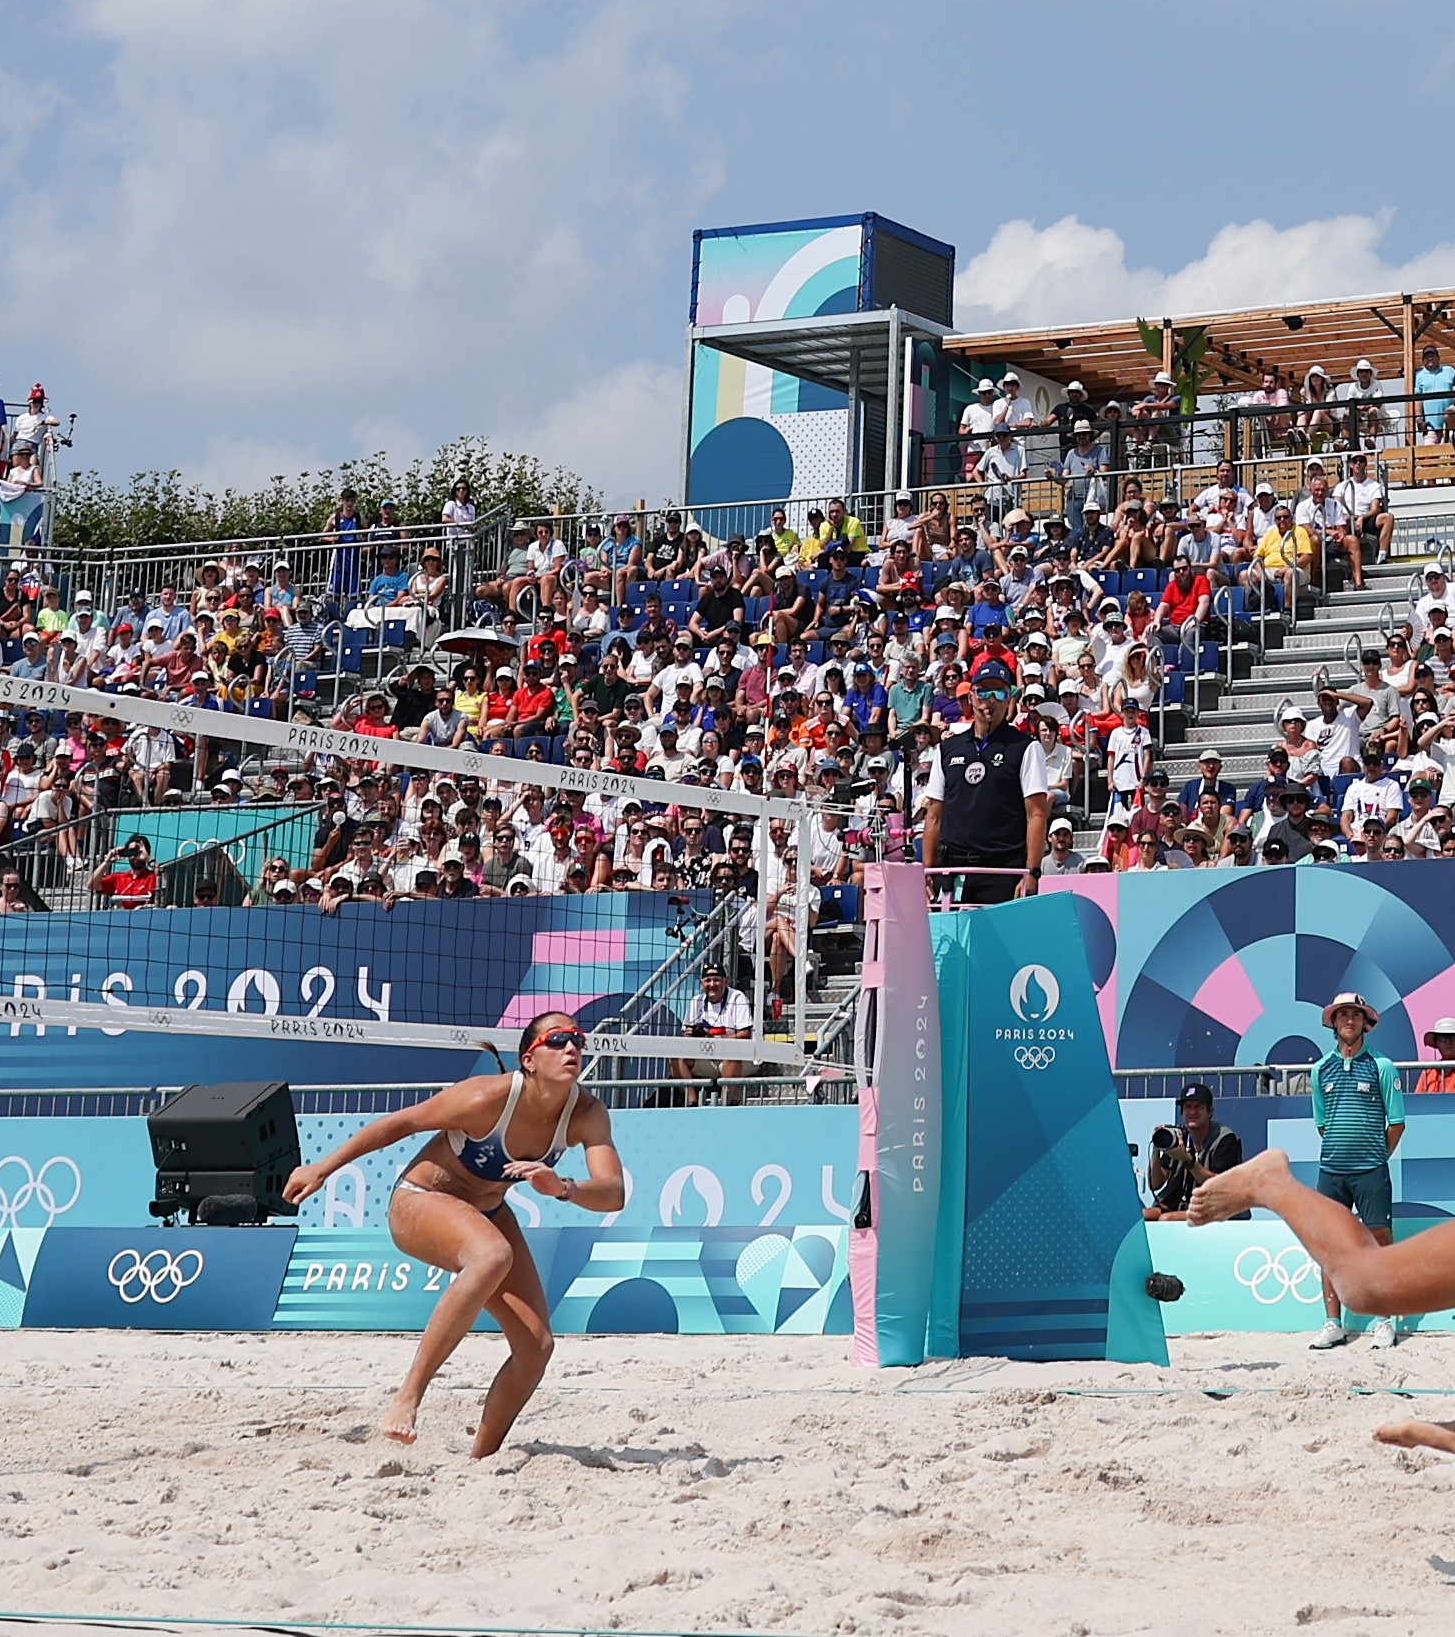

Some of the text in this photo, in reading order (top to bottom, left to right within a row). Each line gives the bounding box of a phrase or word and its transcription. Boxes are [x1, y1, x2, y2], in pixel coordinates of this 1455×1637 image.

[19, 683, 71, 705] 2024
[339, 735, 379, 757] 2024
[602, 775, 636, 794] 2024
[323, 1023, 365, 1040] 2024
[914, 995, 928, 1081] 2024
[1038, 1028, 1075, 1040] 2024
[474, 1153, 488, 1168] 2
